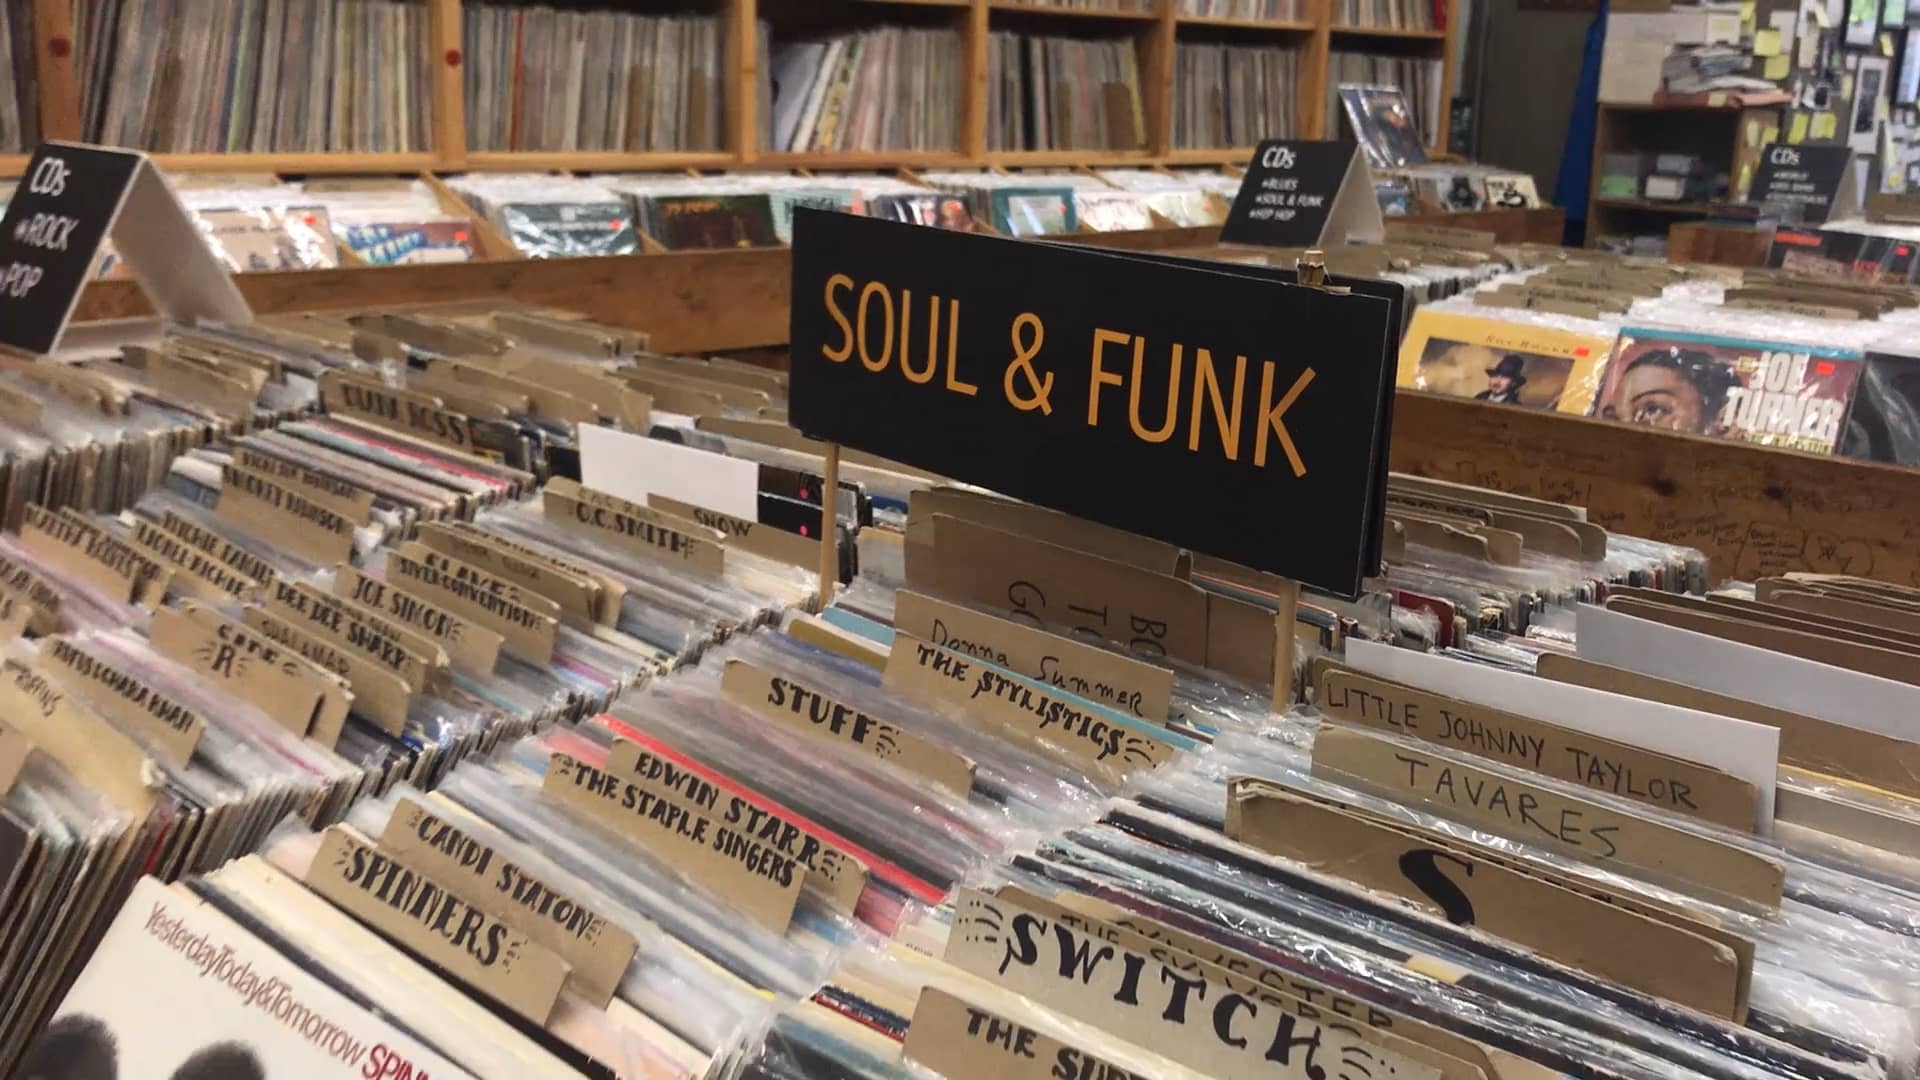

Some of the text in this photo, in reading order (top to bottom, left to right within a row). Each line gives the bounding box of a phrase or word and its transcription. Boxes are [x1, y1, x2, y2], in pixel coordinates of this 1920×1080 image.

[29, 157, 71, 196] CDs
[1261, 146, 1296, 169] CDs
[24, 213, 79, 250] ROCK
[3, 261, 44, 298] POP
[822, 273, 1317, 478] SOUL & FUNK
[1748, 351, 1811, 396] JOE
[1722, 386, 1847, 445] TURNER
[693, 508, 751, 537] SNOW
[275, 581, 308, 614] DEE
[309, 600, 343, 633] DEE
[347, 621, 407, 670] SHARP
[352, 574, 386, 609] JOE
[390, 591, 454, 640] SIMON
[931, 617, 1010, 668] Donna
[768, 676, 878, 745] STUFF
[917, 643, 1125, 760] THE STYLISTICS
[1326, 683, 1698, 810] LITTLE JOHNNY TAYLOR
[571, 764, 798, 889] THE STAPLE SINGERS
[634, 751, 823, 873] EDWIN STARR
[1394, 752, 1619, 858] TAVARES
[343, 845, 508, 968] SPINNERS
[416, 814, 596, 940] CANDI STATON
[1398, 847, 1475, 926] S
[966, 1007, 1037, 1059] THE
[999, 913, 1327, 1080] SWITCH
